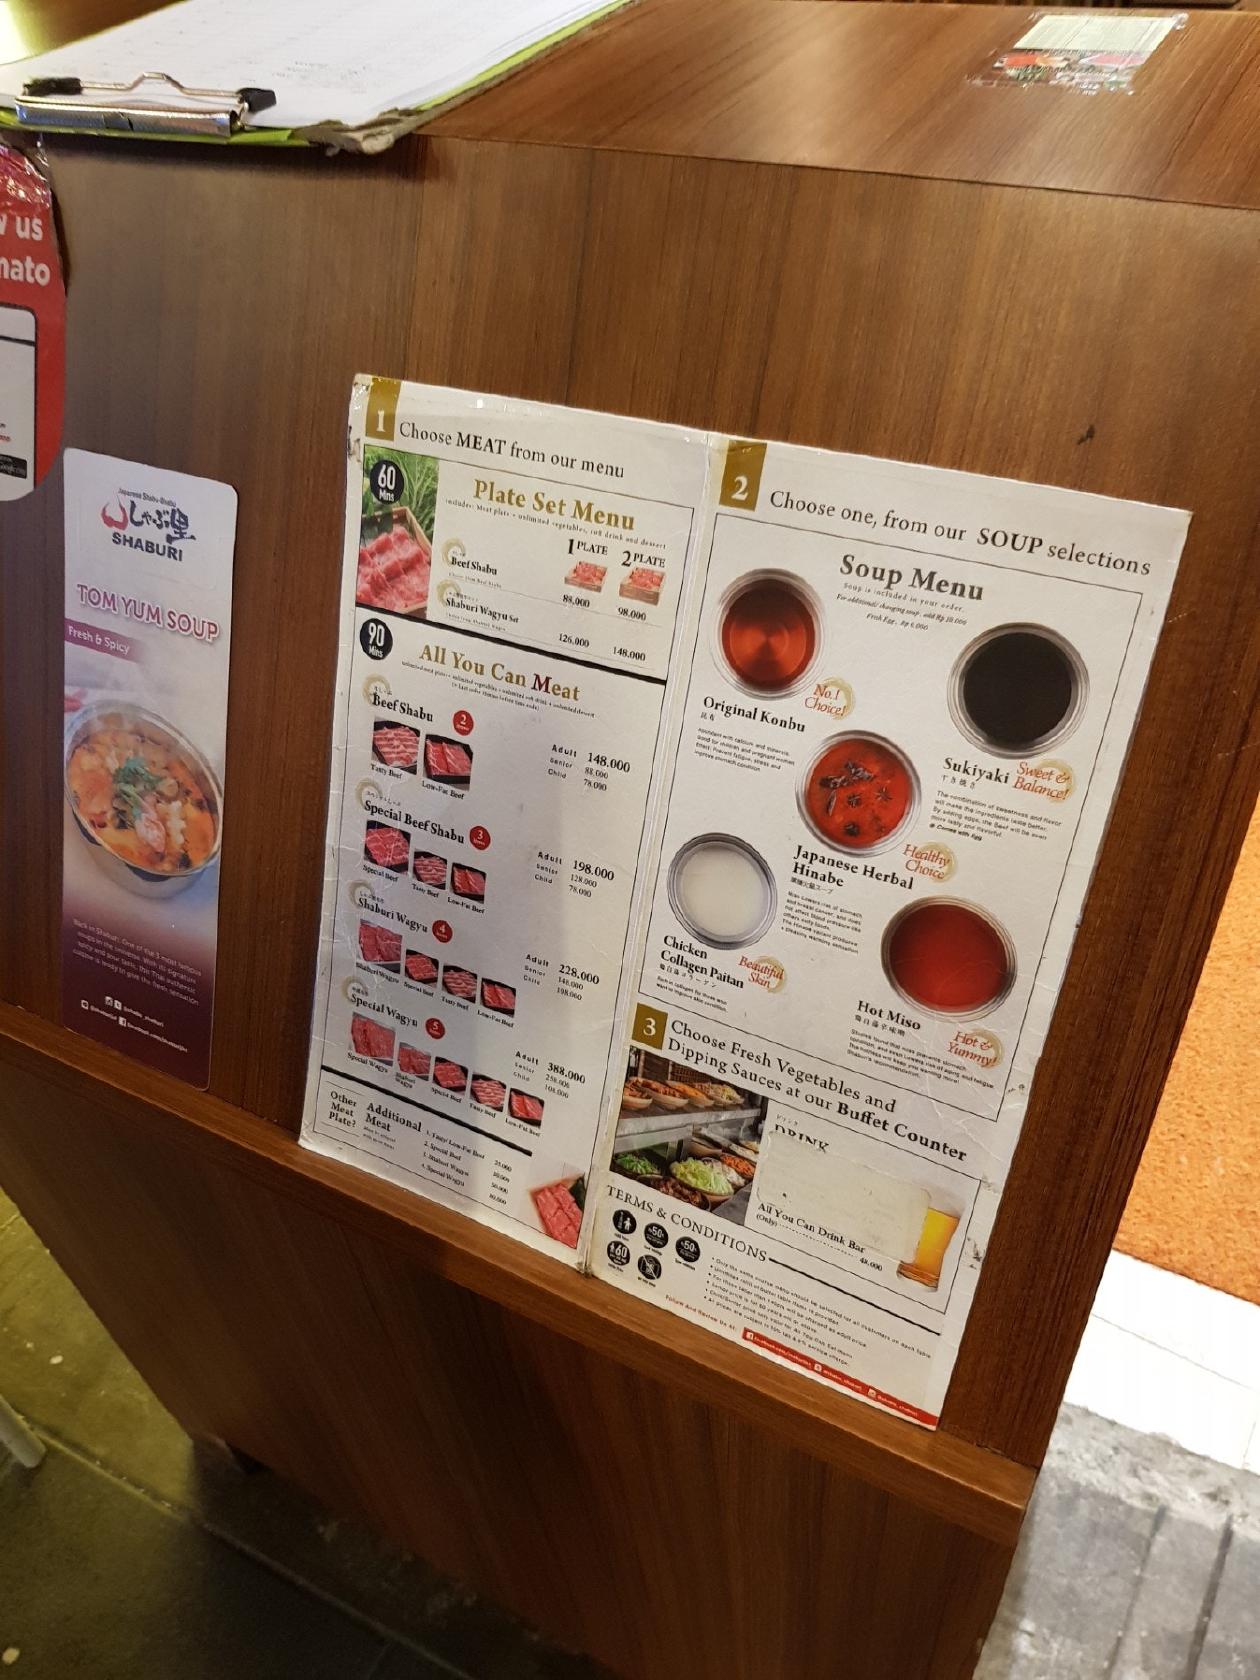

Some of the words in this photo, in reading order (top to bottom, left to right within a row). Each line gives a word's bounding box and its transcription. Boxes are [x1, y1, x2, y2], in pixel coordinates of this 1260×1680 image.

[16, 216, 43, 241] us
[376, 409, 386, 433] 1
[400, 422, 452, 446] Choose
[457, 432, 507, 455] MEAT
[510, 442, 545, 462] from
[550, 453, 577, 470] our
[580, 460, 624, 478] menu
[378, 464, 396, 490] 60
[731, 475, 748, 501] 2
[473, 479, 526, 508] Plate
[532, 491, 567, 516] Set
[573, 499, 635, 531] Menu
[112, 531, 183, 561] SHABURI
[770, 490, 835, 517] Choose
[841, 507, 878, 529] one,
[882, 510, 928, 534] from
[934, 524, 966, 540] our
[977, 527, 1043, 554] SOUP
[1047, 543, 1151, 576] selections
[568, 538, 574, 555] 1
[577, 540, 608, 556] PLATE
[621, 550, 632, 567] 2
[633, 553, 666, 568] PLATE
[451, 556, 471, 570] Beef
[471, 561, 498, 576] Shabu
[840, 554, 902, 591] Soup
[908, 567, 983, 601] Menu
[77, 584, 117, 613] TOM
[121, 598, 162, 625] YUM
[167, 610, 219, 642] SOUP
[445, 597, 478, 613] Shaburi
[479, 605, 508, 622] Wagyu
[509, 615, 519, 623] Set
[617, 606, 647, 621] 98.000
[67, 625, 93, 643] Fresh
[104, 637, 130, 656] Spicy
[367, 623, 385, 646] 90
[559, 633, 590, 648] 126.000
[612, 646, 646, 662] 148.000
[419, 644, 447, 664] All
[450, 652, 485, 676] You
[491, 663, 526, 687] Can
[531, 673, 581, 701] Meat
[372, 692, 399, 712] Beef
[399, 701, 434, 722] Shabu
[460, 714, 467, 725] 2
[703, 696, 758, 720] Original
[760, 711, 806, 732] Konbu
[804, 697, 847, 716] Choice!
[370, 764, 388, 776] Tasty
[388, 769, 402, 779] Beef
[549, 757, 573, 769] Senior
[584, 766, 609, 780] 88.000
[551, 744, 577, 758] Adult
[587, 752, 631, 773] 148.000
[943, 757, 1010, 784] Sukiyaki
[1016, 761, 1054, 780] Sweet
[1055, 772, 1070, 784] &
[422, 780, 448, 795] Low-Fat
[450, 790, 464, 800] Beef
[547, 768, 567, 779] Child
[583, 778, 607, 792] 78.000
[1012, 776, 1069, 800] Balance!
[365, 800, 402, 821] Special
[404, 813, 430, 832] Beef
[430, 822, 465, 844] Shabu
[477, 830, 484, 840] 3
[362, 864, 384, 877] Special
[385, 872, 399, 882] Beef
[536, 863, 558, 875] Senior
[537, 851, 563, 865] Adult
[573, 859, 615, 881] 198.000
[792, 862, 845, 887] Hinabe
[905, 859, 945, 880] Choice
[793, 844, 859, 874] Japanese
[862, 864, 914, 890] Herbal
[902, 844, 951, 868] Healthy
[534, 874, 553, 885] Child
[427, 889, 439, 898] Beef
[358, 897, 394, 920] Shaburi
[395, 911, 428, 933] Wagyu
[472, 905, 485, 914] Beef
[440, 925, 446, 935] 4
[525, 954, 549, 968] Adult
[558, 964, 600, 985] 228.000
[660, 950, 708, 976] Collagen
[709, 966, 744, 989] Paitan
[748, 972, 771, 989] Skin
[663, 935, 708, 960] Chicken
[738, 955, 784, 980] Beautiful
[350, 992, 385, 1013] Special
[386, 1006, 418, 1028] Wagyu
[501, 1018, 514, 1028] Beef
[857, 1000, 885, 1018] Hot
[886, 1010, 921, 1030] Miso
[433, 1022, 439, 1032] 5
[643, 1017, 656, 1036] 3
[954, 1031, 979, 1046] Hot
[981, 1040, 992, 1050] &
[347, 1052, 368, 1065] Special
[369, 1059, 388, 1074] Wagyu
[515, 1051, 539, 1065] Adult
[547, 1062, 586, 1084] 388.000
[671, 1019, 726, 1050] Choose
[731, 1042, 771, 1068] Fresh
[777, 1058, 860, 1101] Vegetables
[865, 1094, 896, 1113] and
[948, 1042, 998, 1067] Yummy!
[513, 1071, 530, 1082] Child
[330, 1091, 357, 1108] Other
[366, 1102, 422, 1132] Additional
[668, 1037, 727, 1074] Dipping
[731, 1063, 782, 1092] Sauces
[786, 1085, 800, 1098] at
[804, 1093, 833, 1110] our
[836, 1101, 890, 1131] Buffet
[894, 1123, 967, 1161] Counter
[329, 1111, 357, 1128] Plate?
[331, 1102, 354, 1117] Meat
[365, 1113, 391, 1132] Meat
[607, 1185, 654, 1213] TERMS
[657, 1207, 667, 1219] &
[671, 1213, 767, 1262] CONDITIONS
[756, 1213, 778, 1227] (Only)
[758, 1203, 772, 1214] All
[774, 1209, 793, 1223] You
[796, 1218, 815, 1233] Can
[818, 1226, 845, 1245] Drink
[848, 1239, 866, 1254] Bar
